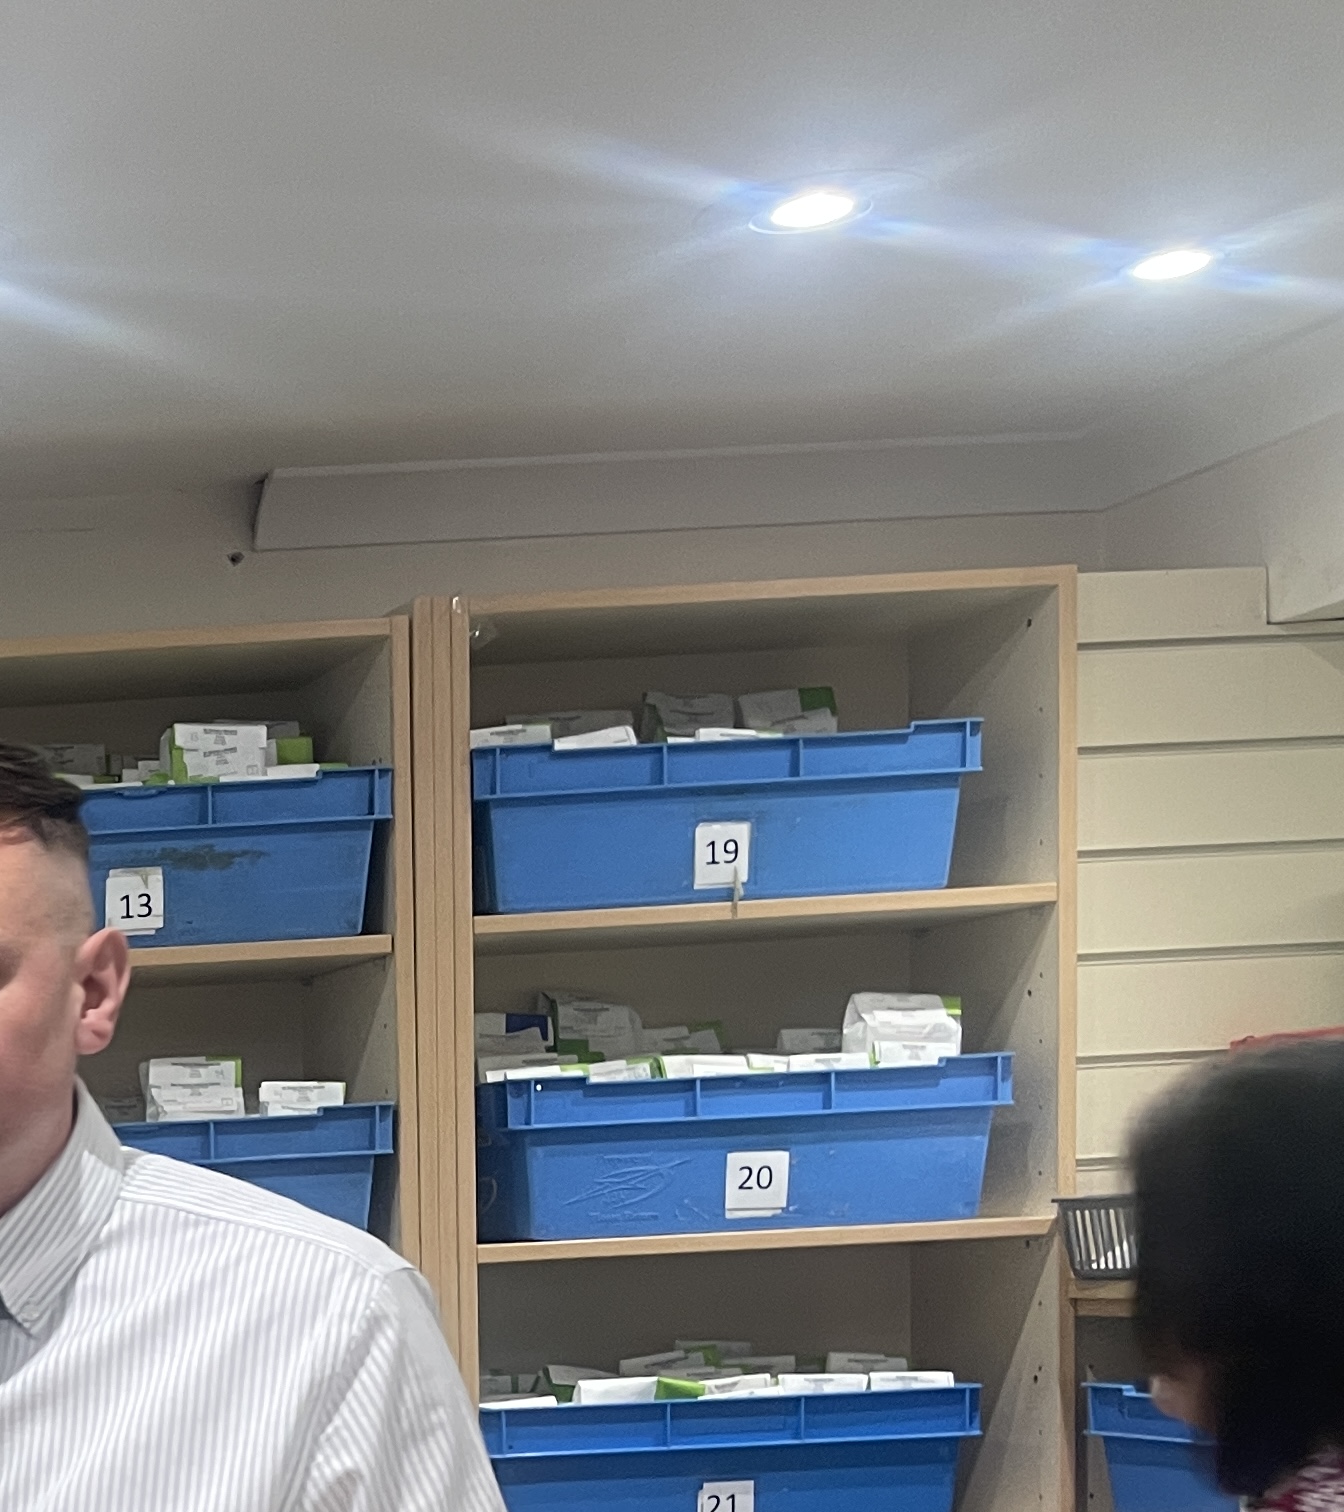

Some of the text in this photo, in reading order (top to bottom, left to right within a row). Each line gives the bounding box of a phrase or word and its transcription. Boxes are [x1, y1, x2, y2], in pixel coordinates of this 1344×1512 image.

[706, 838, 739, 866] 19
[119, 892, 153, 920] 13
[738, 1165, 773, 1190] 20
